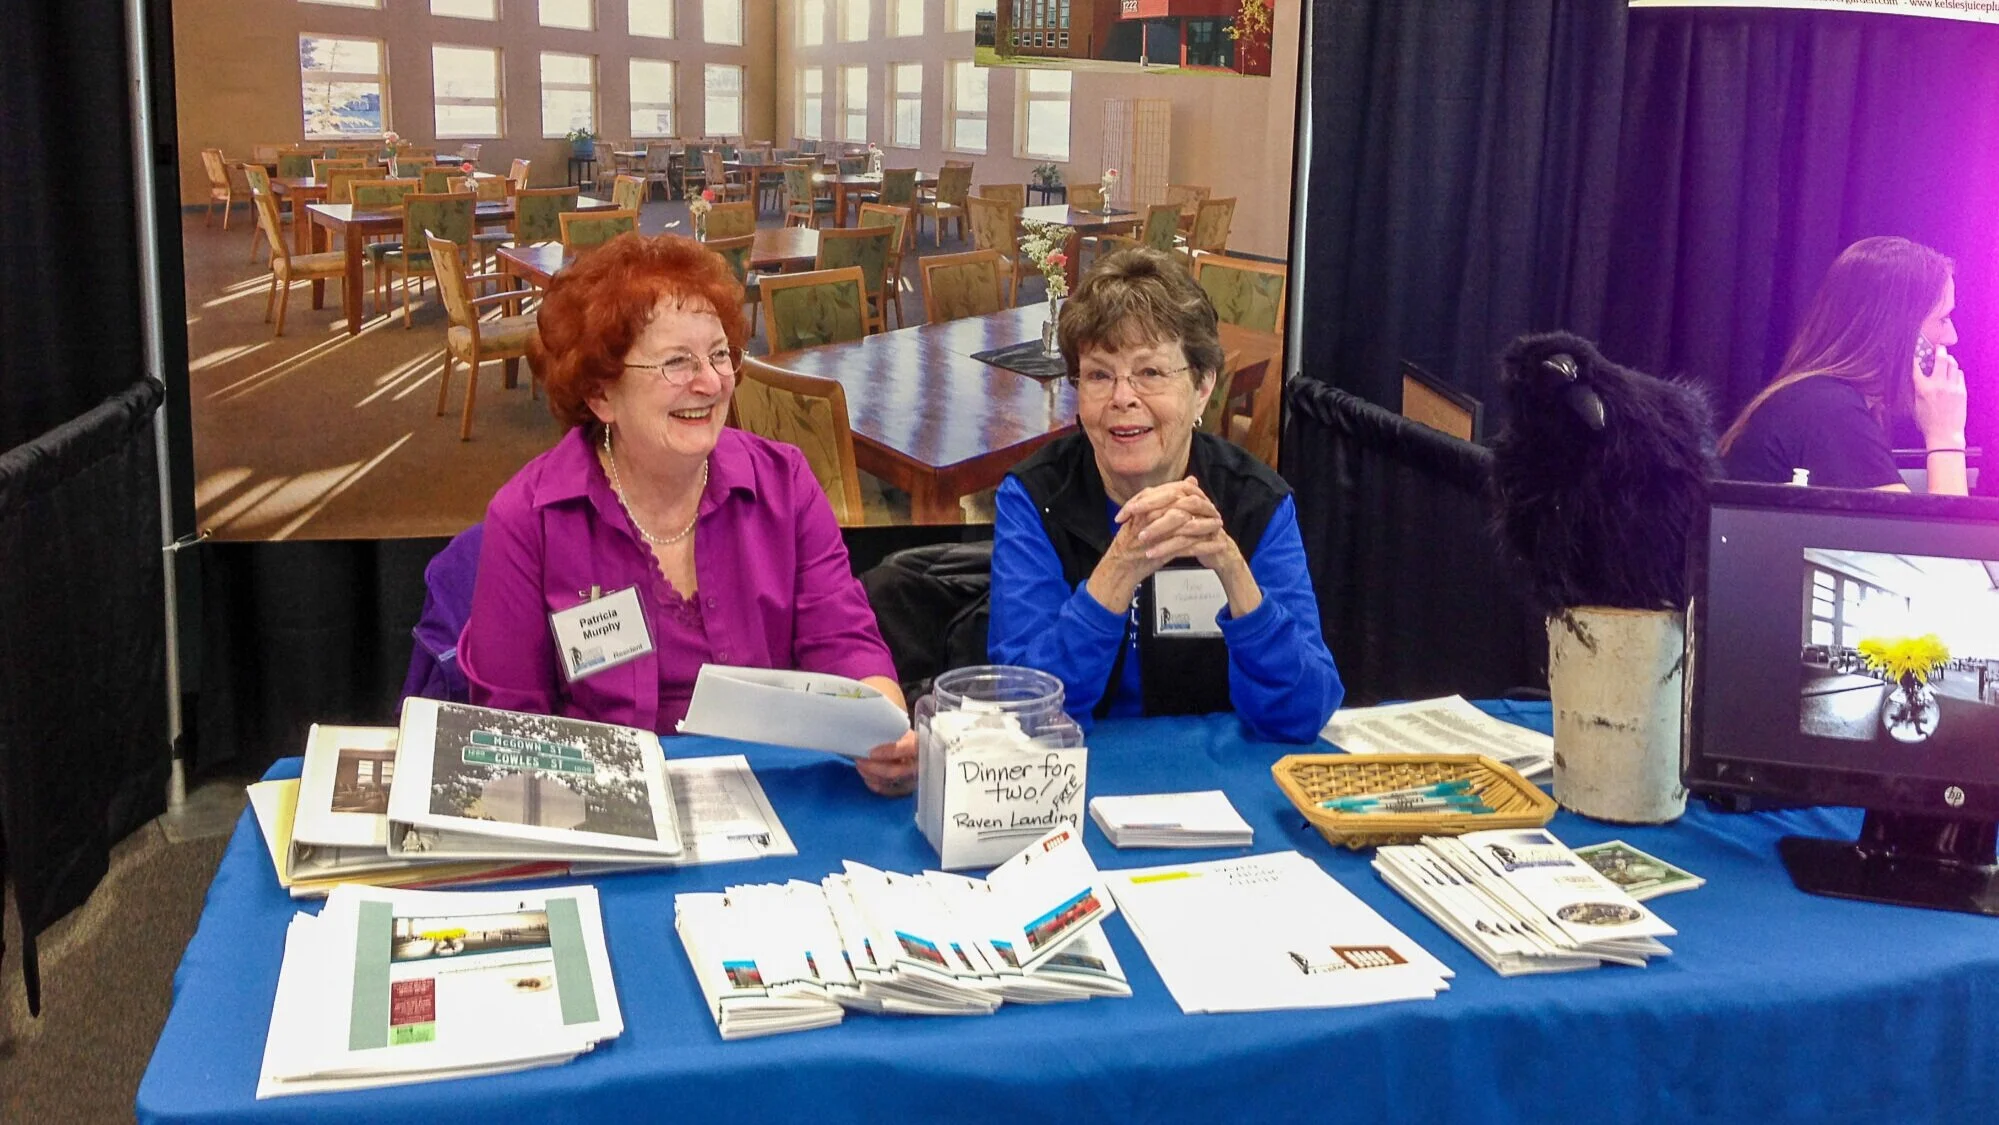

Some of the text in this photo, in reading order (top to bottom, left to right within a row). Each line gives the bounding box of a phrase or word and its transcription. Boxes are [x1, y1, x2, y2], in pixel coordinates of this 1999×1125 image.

[579, 608, 618, 628] Patricia
[583, 621, 621, 641] Murphy
[493, 736, 562, 755] McGOWN ST
[494, 753, 540, 767] COWLES
[551, 759, 563, 770] ST
[958, 753, 1076, 784] Dinner for
[985, 778, 1054, 805] two!
[1052, 774, 1078, 812] FREE
[953, 811, 1078, 829] Raven Landing
